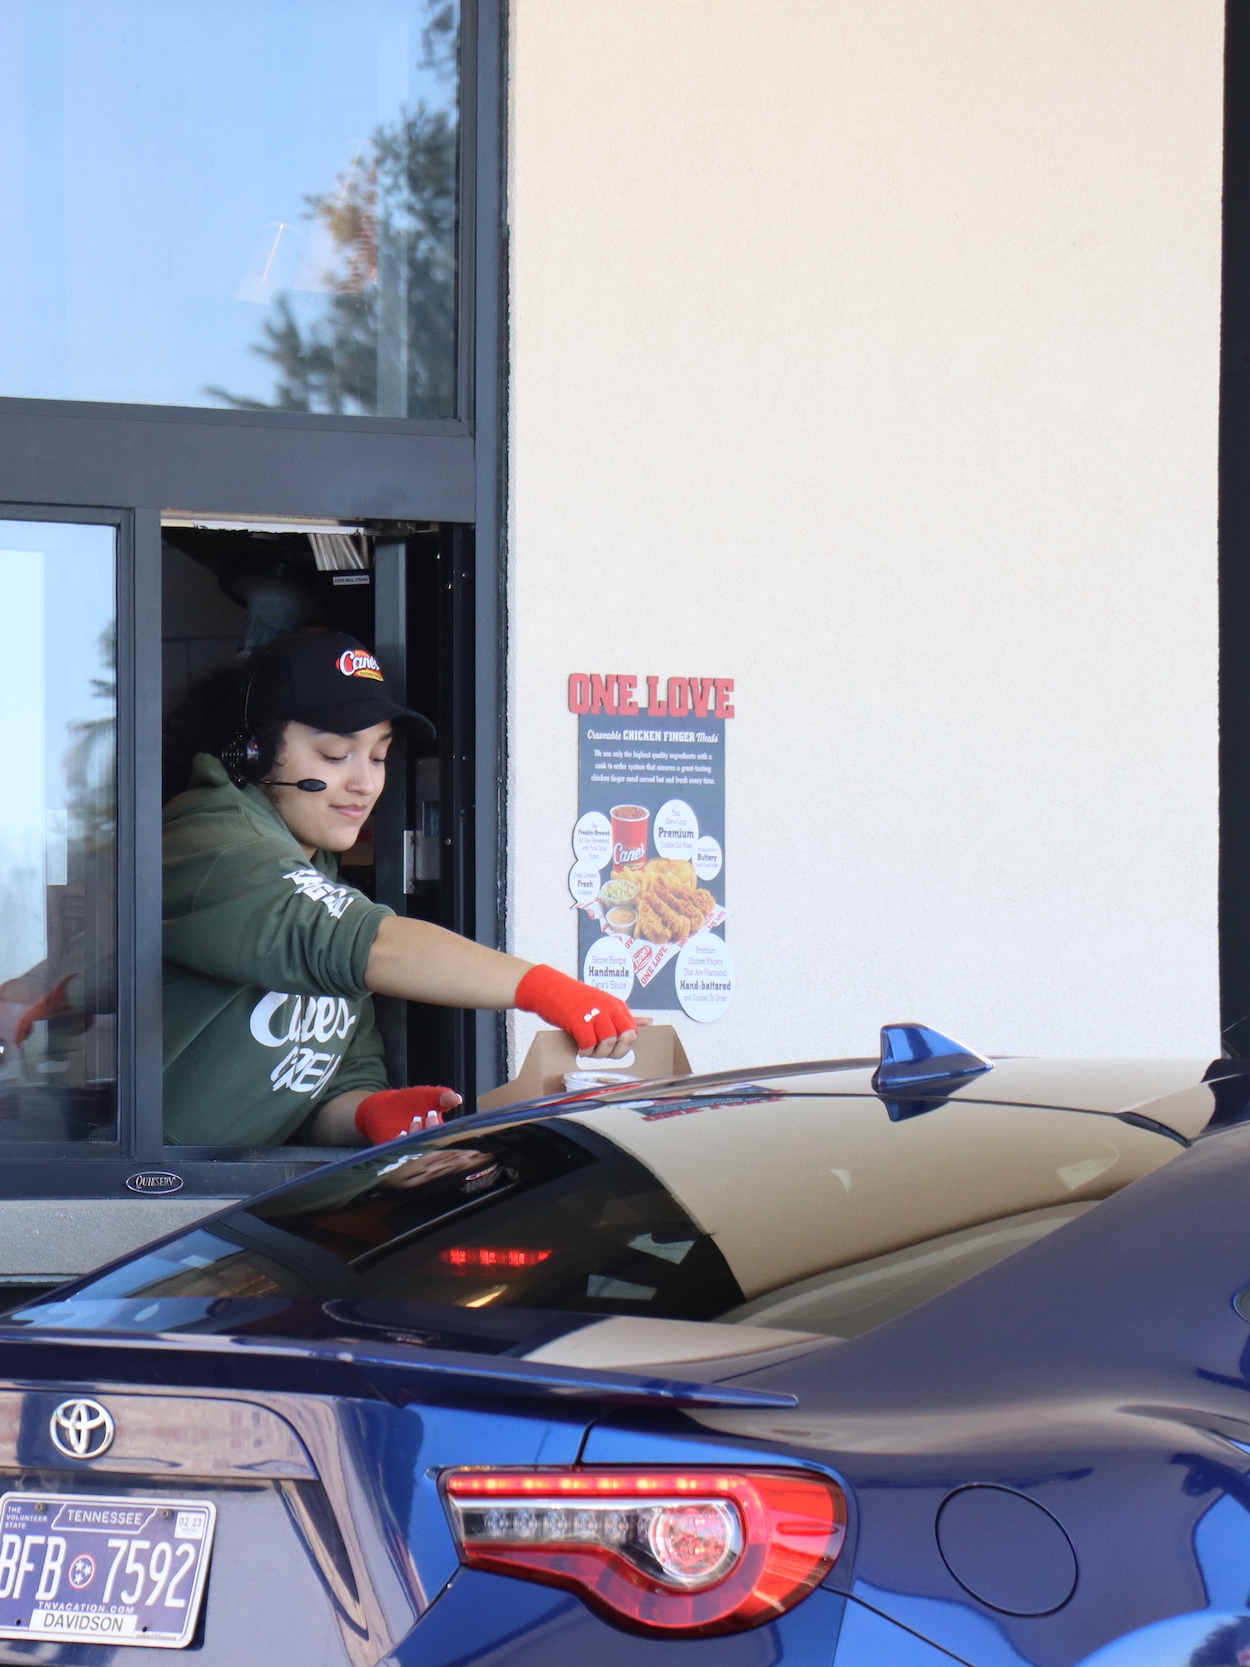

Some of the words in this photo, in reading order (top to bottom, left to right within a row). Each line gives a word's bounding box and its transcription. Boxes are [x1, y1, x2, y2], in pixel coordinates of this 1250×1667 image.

[568, 673, 639, 716] ONE
[646, 675, 735, 719] LOVE
[587, 729, 622, 740] Craveable
[622, 730, 662, 742] CHICKEN
[663, 730, 696, 742] FINGER
[612, 750, 623, 758] only
[633, 751, 651, 760] highest
[652, 752, 668, 760] quality
[670, 752, 696, 760] ingredients
[594, 762, 606, 770] cook
[614, 762, 627, 770] order
[628, 764, 646, 772] system
[591, 774, 610, 782] chicken
[610, 774, 626, 784] finger
[675, 776, 688, 784] fresh
[658, 826, 694, 838] Premium
[613, 842, 646, 864] Cane's
[697, 853, 717, 862] Buttery
[577, 880, 593, 888] Fresh
[592, 956, 608, 964] Secret
[610, 956, 626, 966] Recipe
[640, 966, 655, 986] ONE
[652, 946, 668, 967] LOVE
[588, 966, 630, 977] Handmade
[680, 980, 732, 990] Hand-battered
[6, 1514, 48, 1522] VOLUNTEER
[68, 1509, 143, 1525] TENNESSEE
[179, 1517, 202, 1527] 02-23
[102, 1539, 196, 1608] 7592
[38, 1601, 134, 1614] TNVACATION.COM
[43, 1613, 124, 1632] DAVIDSON
